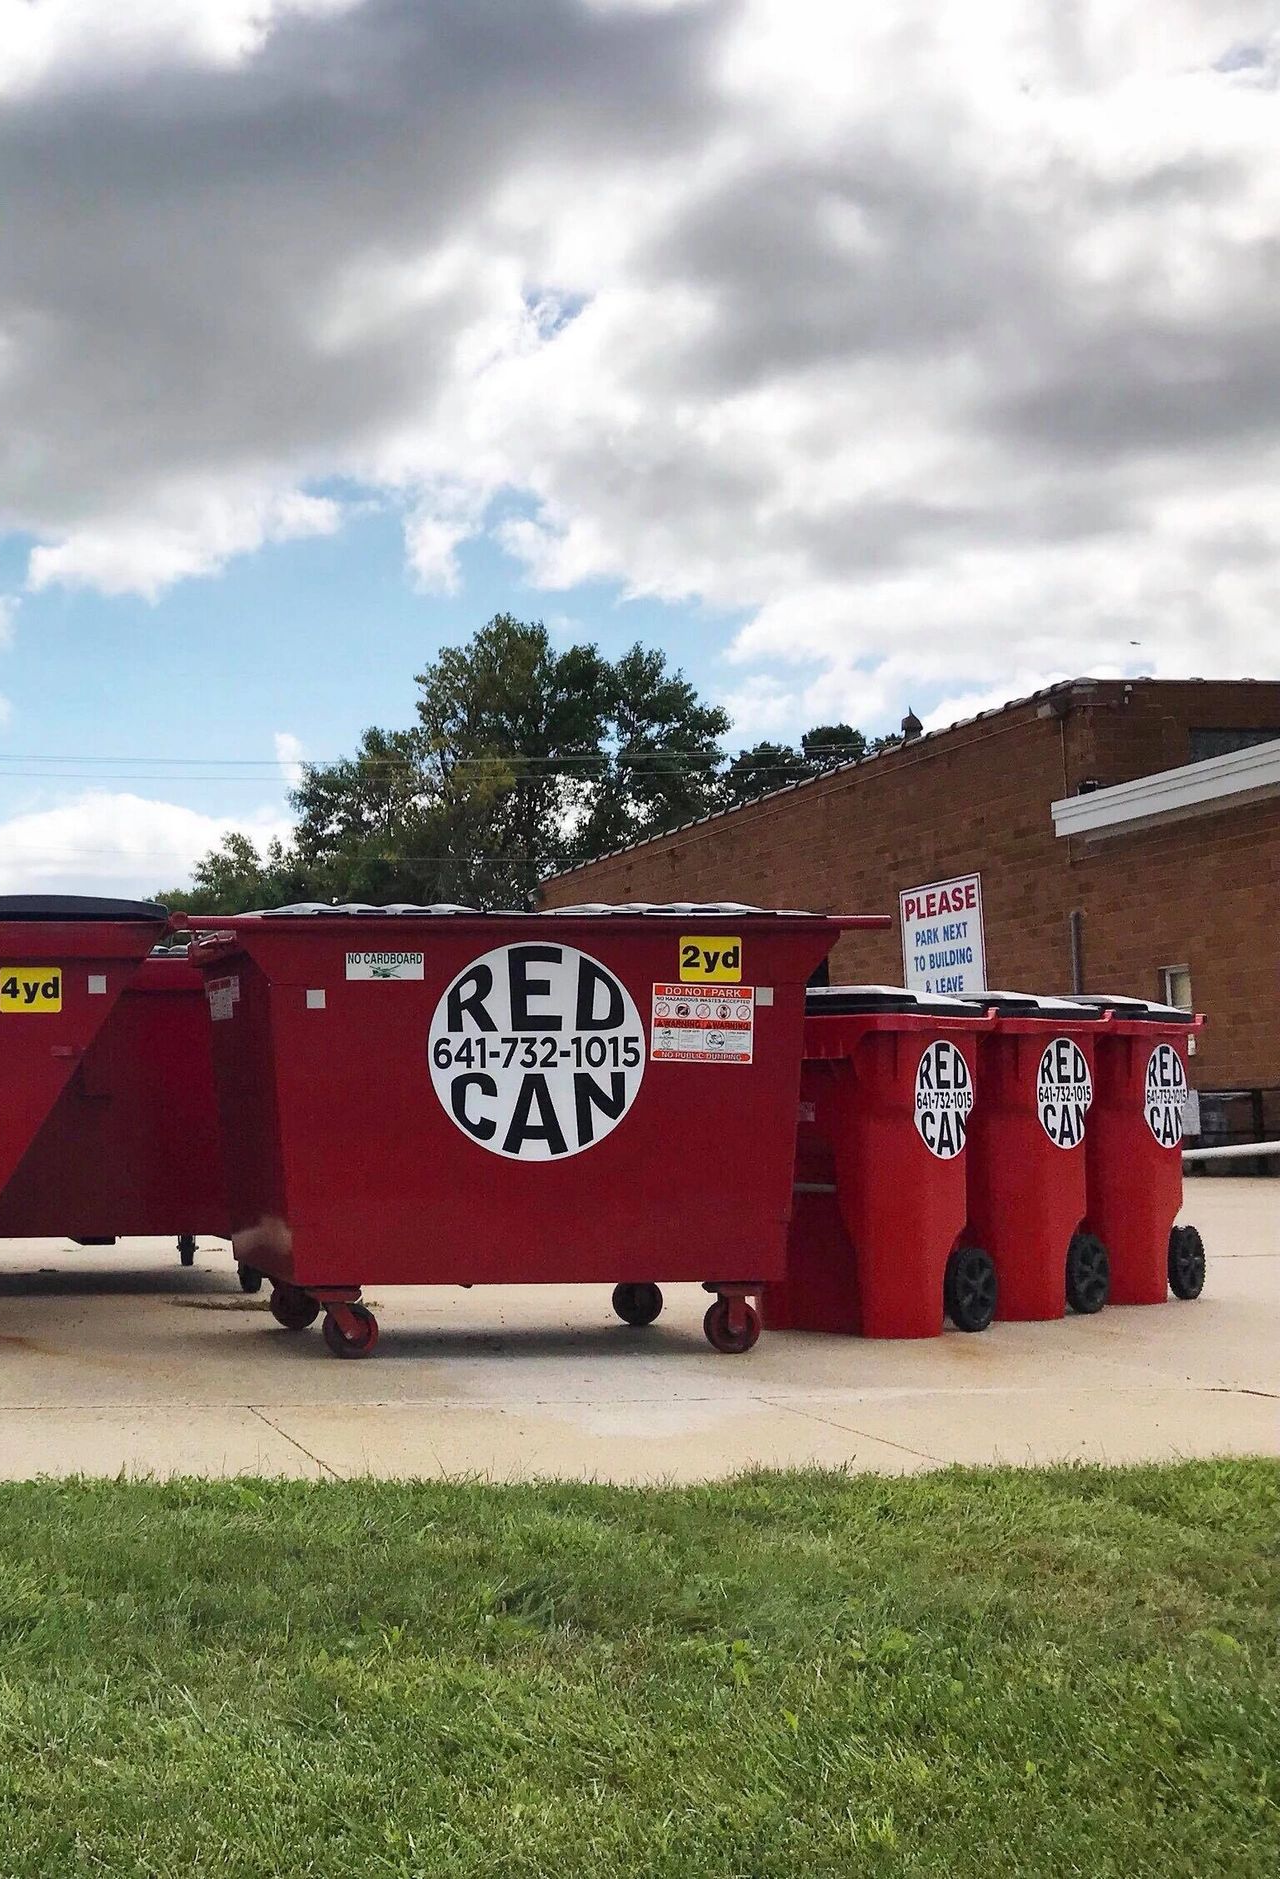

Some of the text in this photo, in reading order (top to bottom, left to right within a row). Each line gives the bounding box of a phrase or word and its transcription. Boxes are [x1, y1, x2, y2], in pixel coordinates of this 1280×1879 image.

[905, 884, 976, 921] PLEASE
[915, 922, 968, 947] PARK NEXT
[347, 953, 423, 965] NO CARDBOARD
[914, 946, 973, 972] TO BUILDING
[447, 945, 625, 1032] RED
[664, 986, 741, 998] DO NOT PARK
[926, 975, 964, 993] & LEAVE
[433, 1036, 641, 1069] 641-732-1015
[707, 1053, 741, 1061] DUMPING
[920, 1043, 968, 1089] RED
[1041, 1040, 1087, 1083] RED
[1149, 1046, 1183, 1087] RED
[917, 1092, 972, 1109] 641-732-1015
[1039, 1086, 1091, 1102] 641-732-1015
[451, 1071, 626, 1155] CAN
[1043, 1104, 1087, 1146] CAN
[1150, 1106, 1183, 1146] CAN
[921, 1111, 967, 1156] CAN
